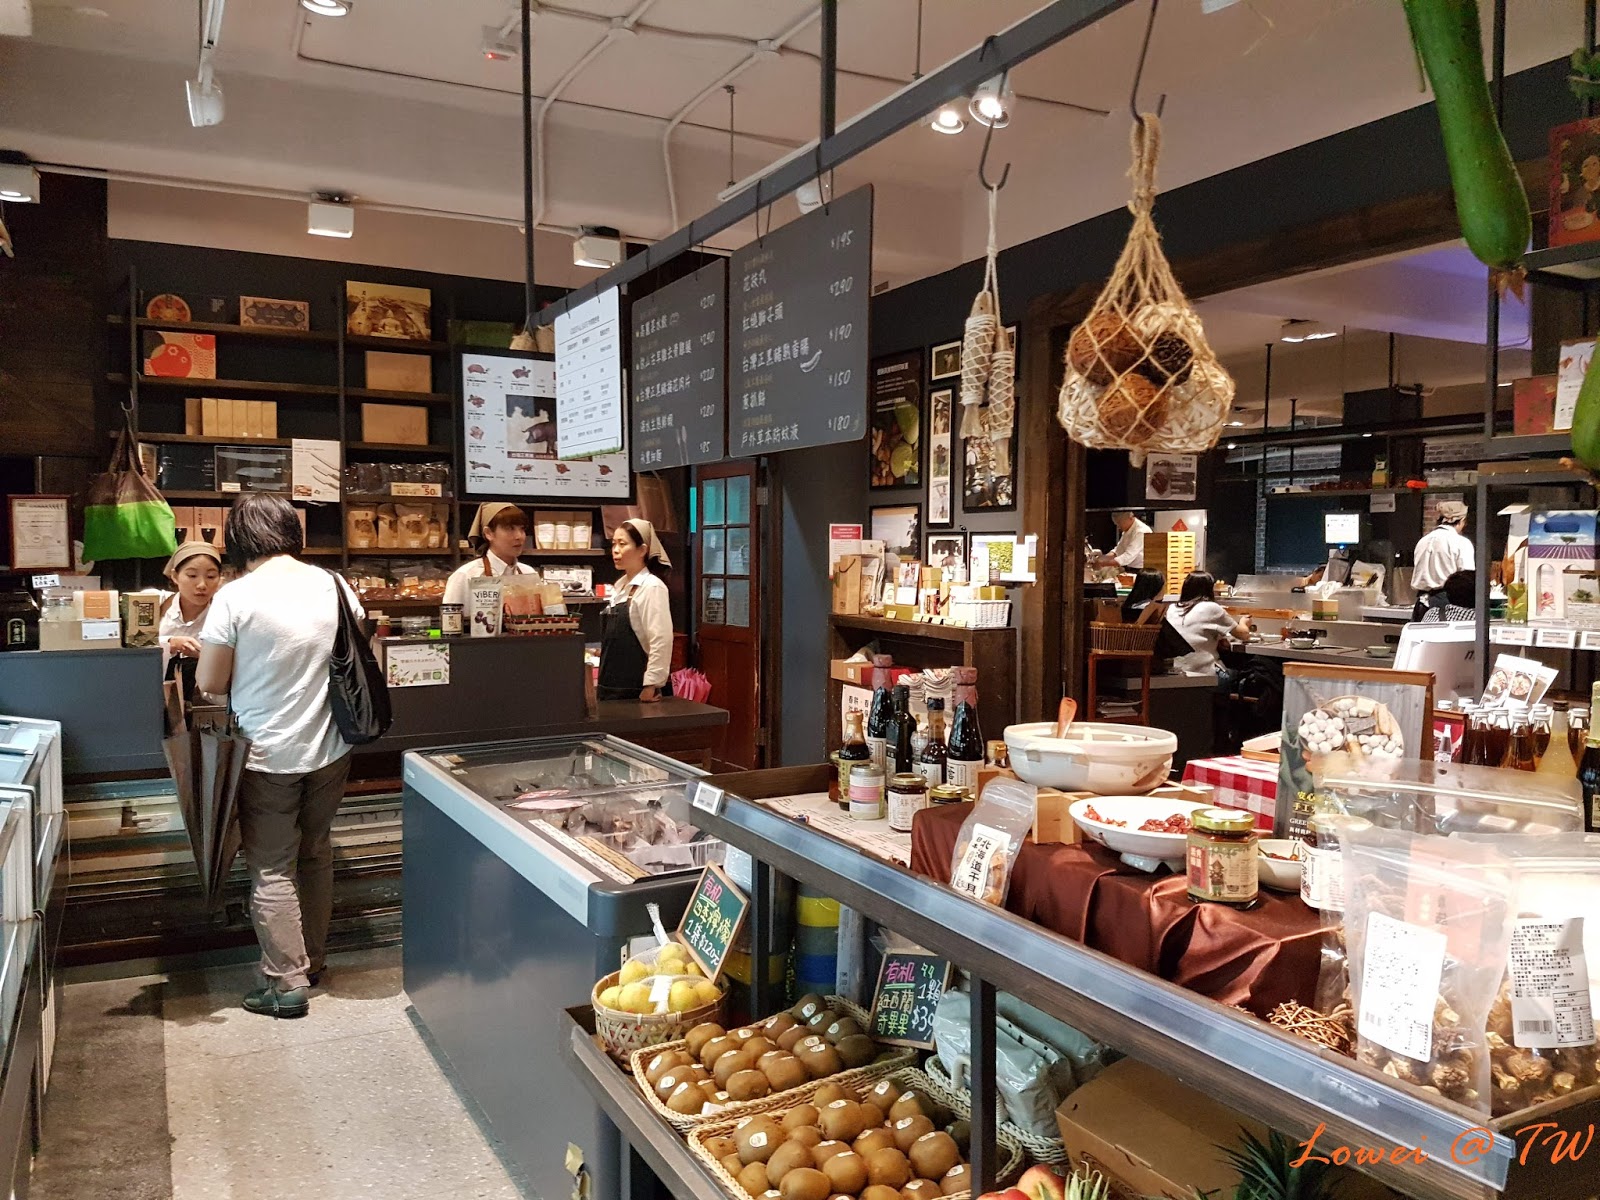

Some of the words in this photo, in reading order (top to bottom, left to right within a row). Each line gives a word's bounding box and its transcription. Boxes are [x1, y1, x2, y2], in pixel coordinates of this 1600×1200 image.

[830, 230, 854, 250] $195
[829, 276, 853, 297] $290
[829, 323, 852, 343] $190
[828, 369, 851, 388] $150
[828, 414, 850, 432] $180
[1289, 817, 1309, 827] GREE
[965, 838, 992, 895] 北海道干貝
[692, 899, 732, 946] 四季檸檬
[876, 989, 915, 1015] 紐西蘭
[877, 1010, 910, 1037] 奇異果
